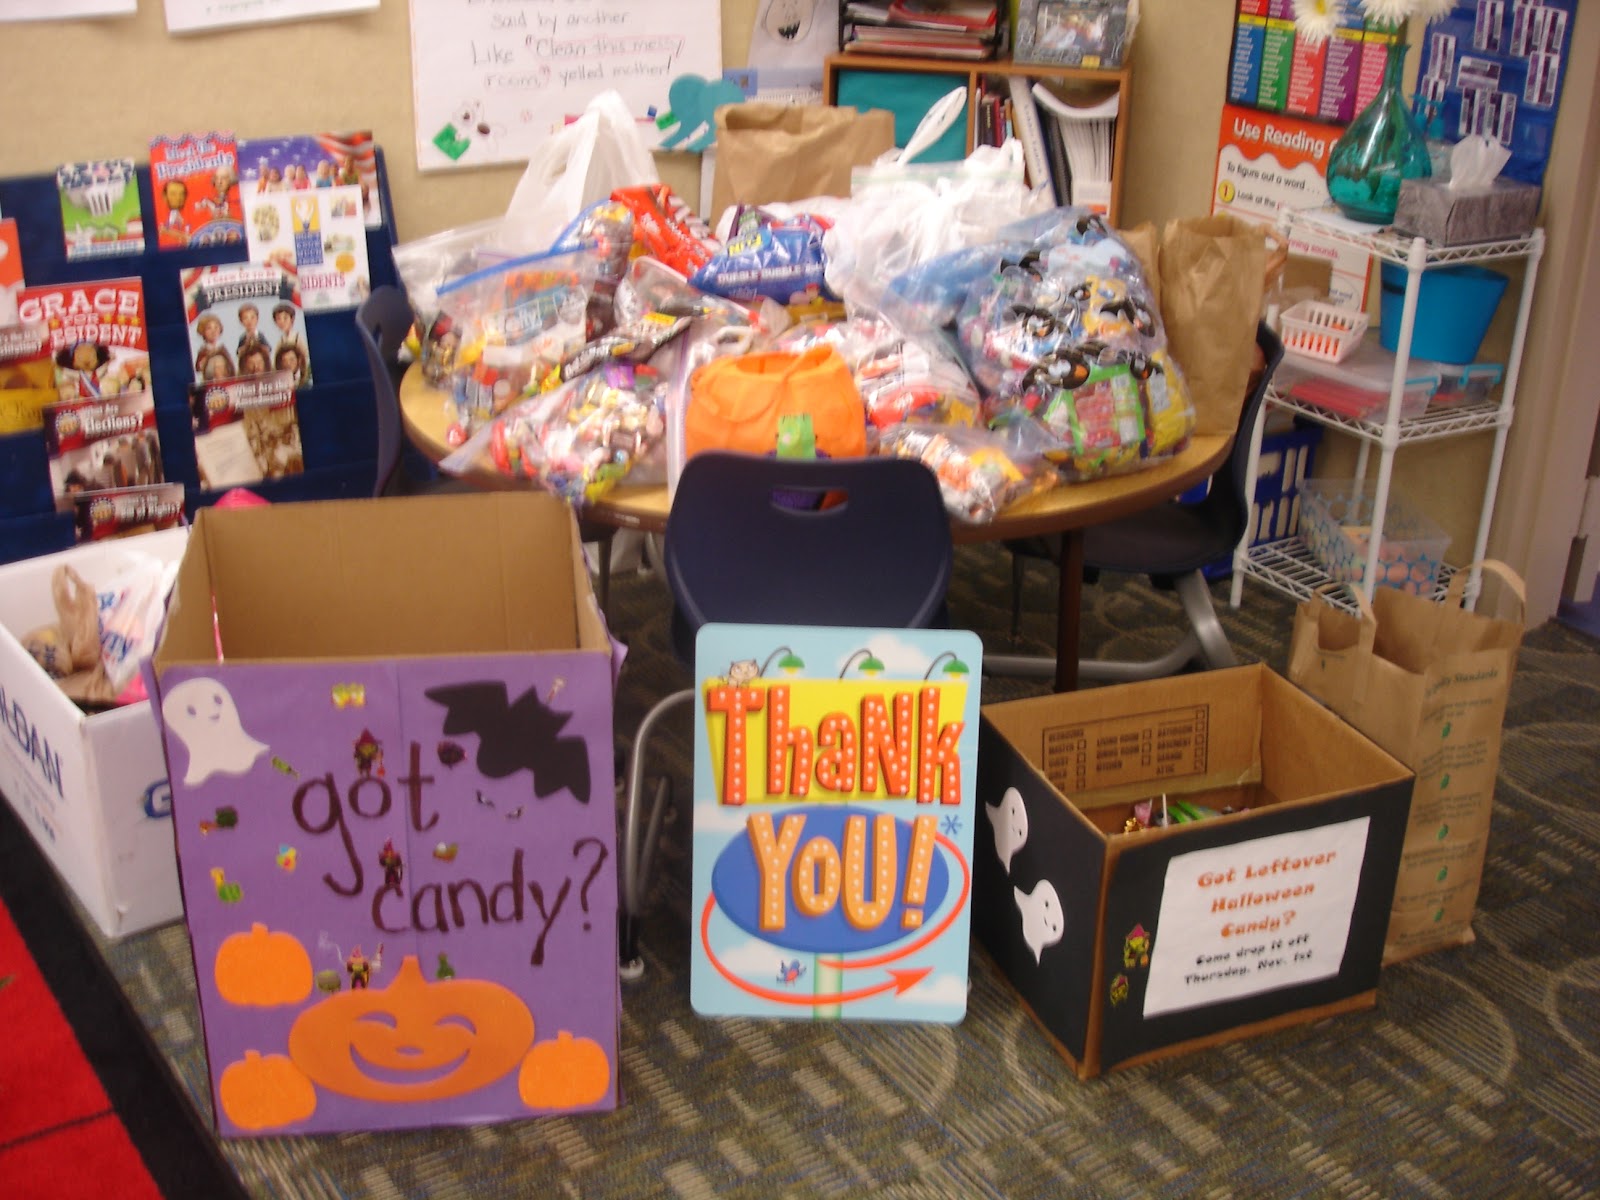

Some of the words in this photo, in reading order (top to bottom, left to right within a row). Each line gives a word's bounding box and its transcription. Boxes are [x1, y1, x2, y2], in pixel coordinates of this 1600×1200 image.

[491, 10, 527, 29] said
[537, 11, 557, 34] by
[566, 11, 630, 26] another
[471, 40, 514, 65] Like
[592, 39, 627, 54] this
[559, 63, 604, 87] yelled
[1233, 117, 1260, 139] Use
[1264, 123, 1325, 160] Reading
[1227, 161, 1236, 173] To
[1237, 164, 1260, 181] figure
[1261, 169, 1275, 181] out
[1283, 176, 1306, 191] word
[1237, 189, 1254, 202] Look
[20, 288, 140, 322] GRACE
[206, 282, 281, 301] PRESIDENT
[63, 313, 98, 328] FOR
[51, 323, 142, 352] ESIDENT
[85, 411, 143, 434] Elections?
[292, 740, 439, 897] got
[1197, 866, 1236, 888] Got
[1245, 851, 1337, 880] Leftover
[371, 837, 608, 967] candy?
[1210, 883, 1315, 913] Halloween
[1221, 910, 1296, 939] Candy?
[1196, 952, 1231, 966] Come
[1236, 945, 1265, 959] drop
[1271, 939, 1282, 951] it
[1288, 932, 1310, 947] off
